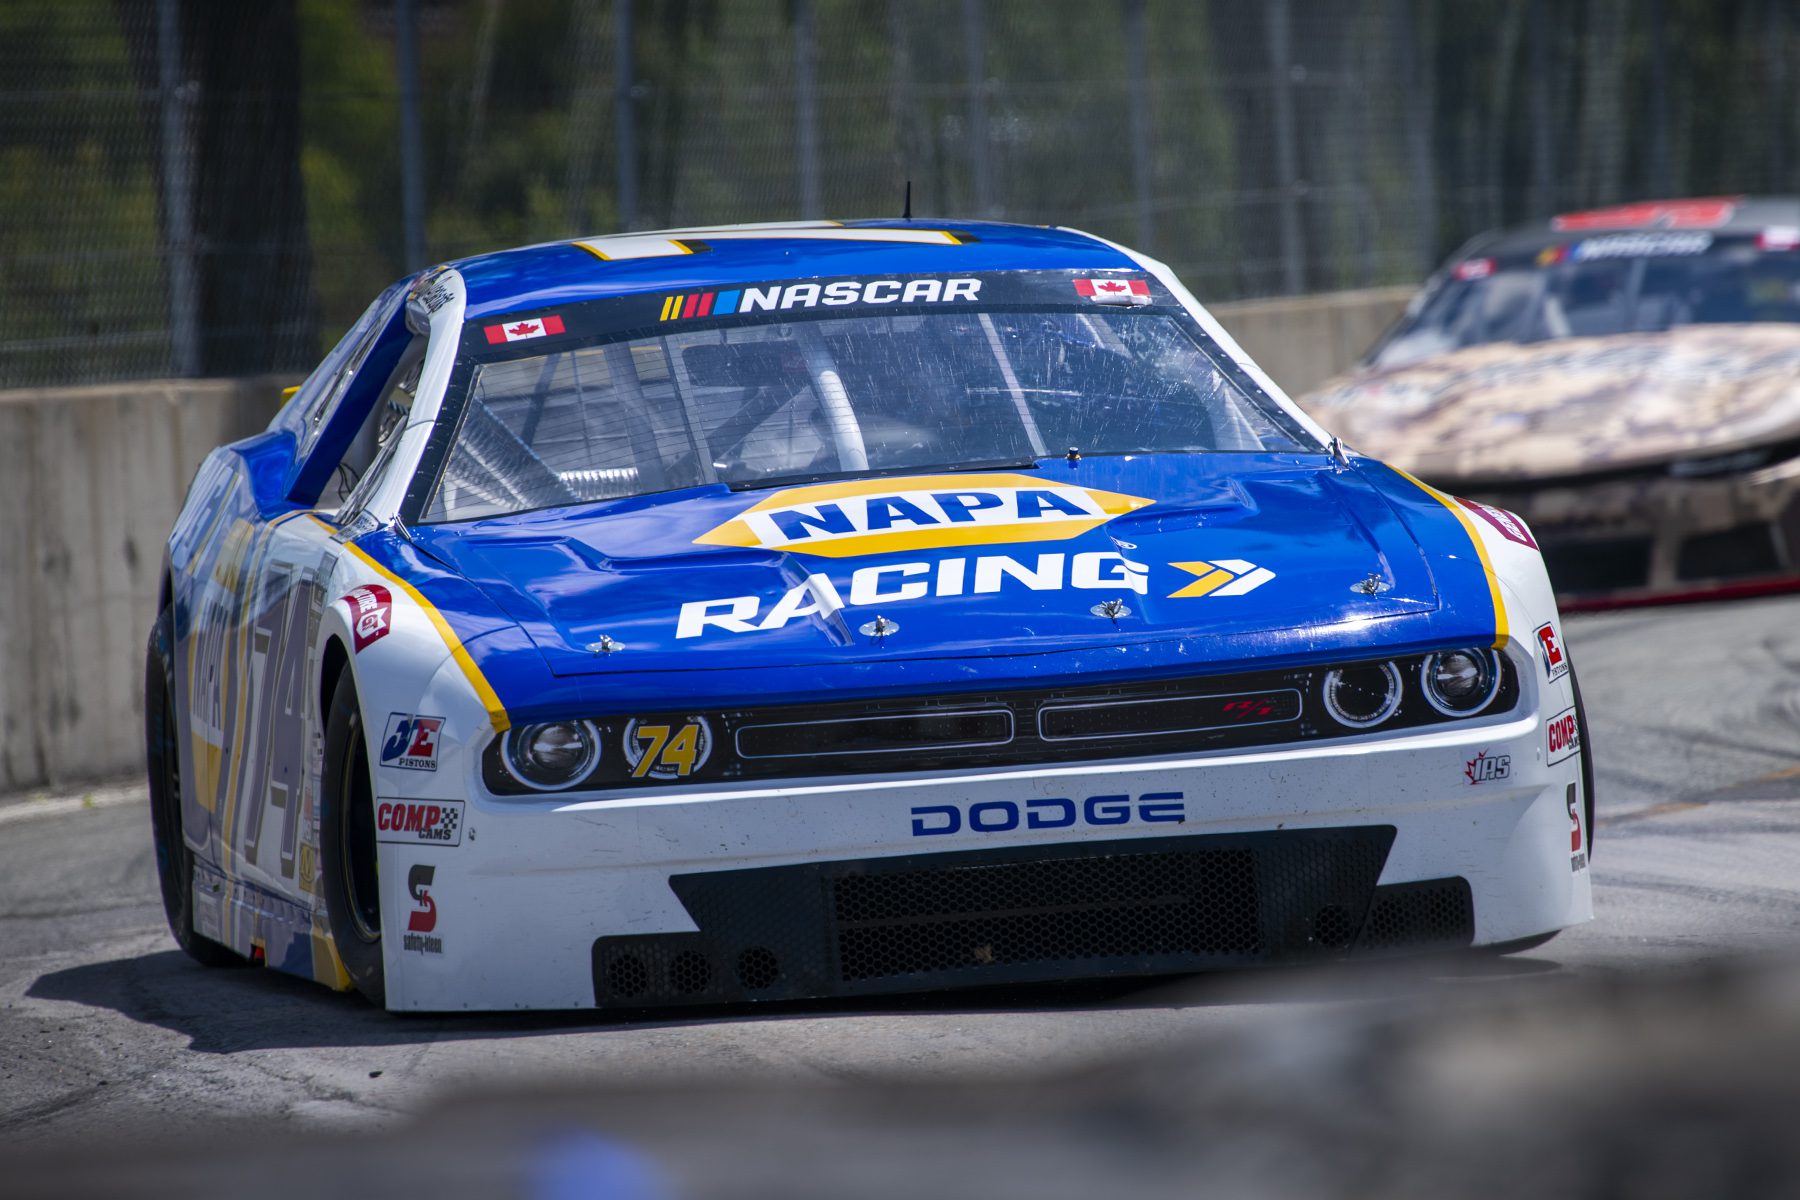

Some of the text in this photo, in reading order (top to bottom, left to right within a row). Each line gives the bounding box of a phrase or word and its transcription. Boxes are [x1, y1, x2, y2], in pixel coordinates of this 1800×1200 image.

[738, 278, 982, 313] NASCAR
[767, 489, 1091, 540] NAPA
[676, 551, 1149, 639] RACING
[631, 724, 699, 778] 74
[1548, 714, 1575, 752] COMP
[398, 758, 437, 769] PISTONS
[1472, 755, 1511, 781] IAS
[378, 803, 441, 832] COMP
[911, 791, 1186, 837] DODGE
[418, 827, 452, 840] CAMS
